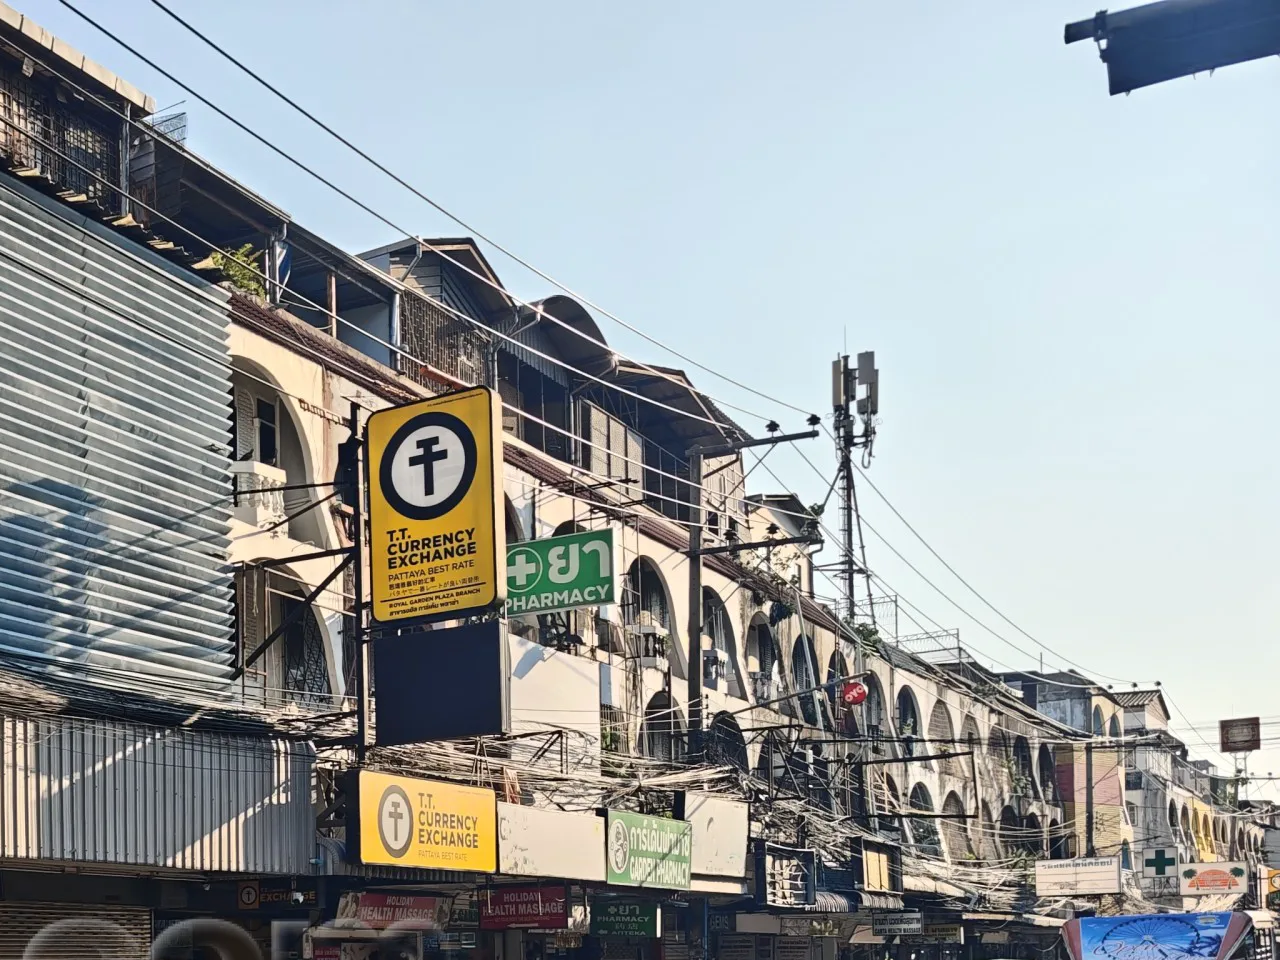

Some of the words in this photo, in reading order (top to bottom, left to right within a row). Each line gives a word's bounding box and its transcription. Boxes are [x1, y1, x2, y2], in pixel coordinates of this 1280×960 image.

[386, 528, 411, 542] T.T.
[386, 528, 476, 556] CURRENCY
[387, 542, 477, 570] EXCHANGE
[547, 539, 611, 584] ยา
[388, 569, 426, 583] PATTAYA
[428, 563, 450, 576] BEST
[451, 559, 475, 571] RATE
[389, 600, 408, 609] ROYAL
[409, 596, 434, 606] GARDEN
[434, 592, 454, 602] PLAZA
[455, 587, 481, 597] BRANCH
[505, 584, 610, 612] PHARMACY
[844, 685, 865, 703] OYO
[418, 793, 436, 810] T.T.
[418, 811, 478, 831] CURRENCY
[418, 829, 479, 849] EXCHANGE
[418, 850, 441, 860] PATTAYA
[442, 852, 455, 860] BEST
[455, 853, 468, 862] RATE
[630, 856, 655, 882] GARDEN
[656, 859, 689, 886] PHARMACY
[260, 890, 316, 903] EXCHAGE
[386, 896, 416, 906] HOLIDAY
[504, 891, 539, 903] HOLIDAY
[360, 906, 393, 920] HEALTH
[394, 907, 434, 922] MASSAGE
[482, 904, 516, 917] HEALTH
[518, 902, 564, 916] MASSAGE
[619, 904, 640, 915] ยา
